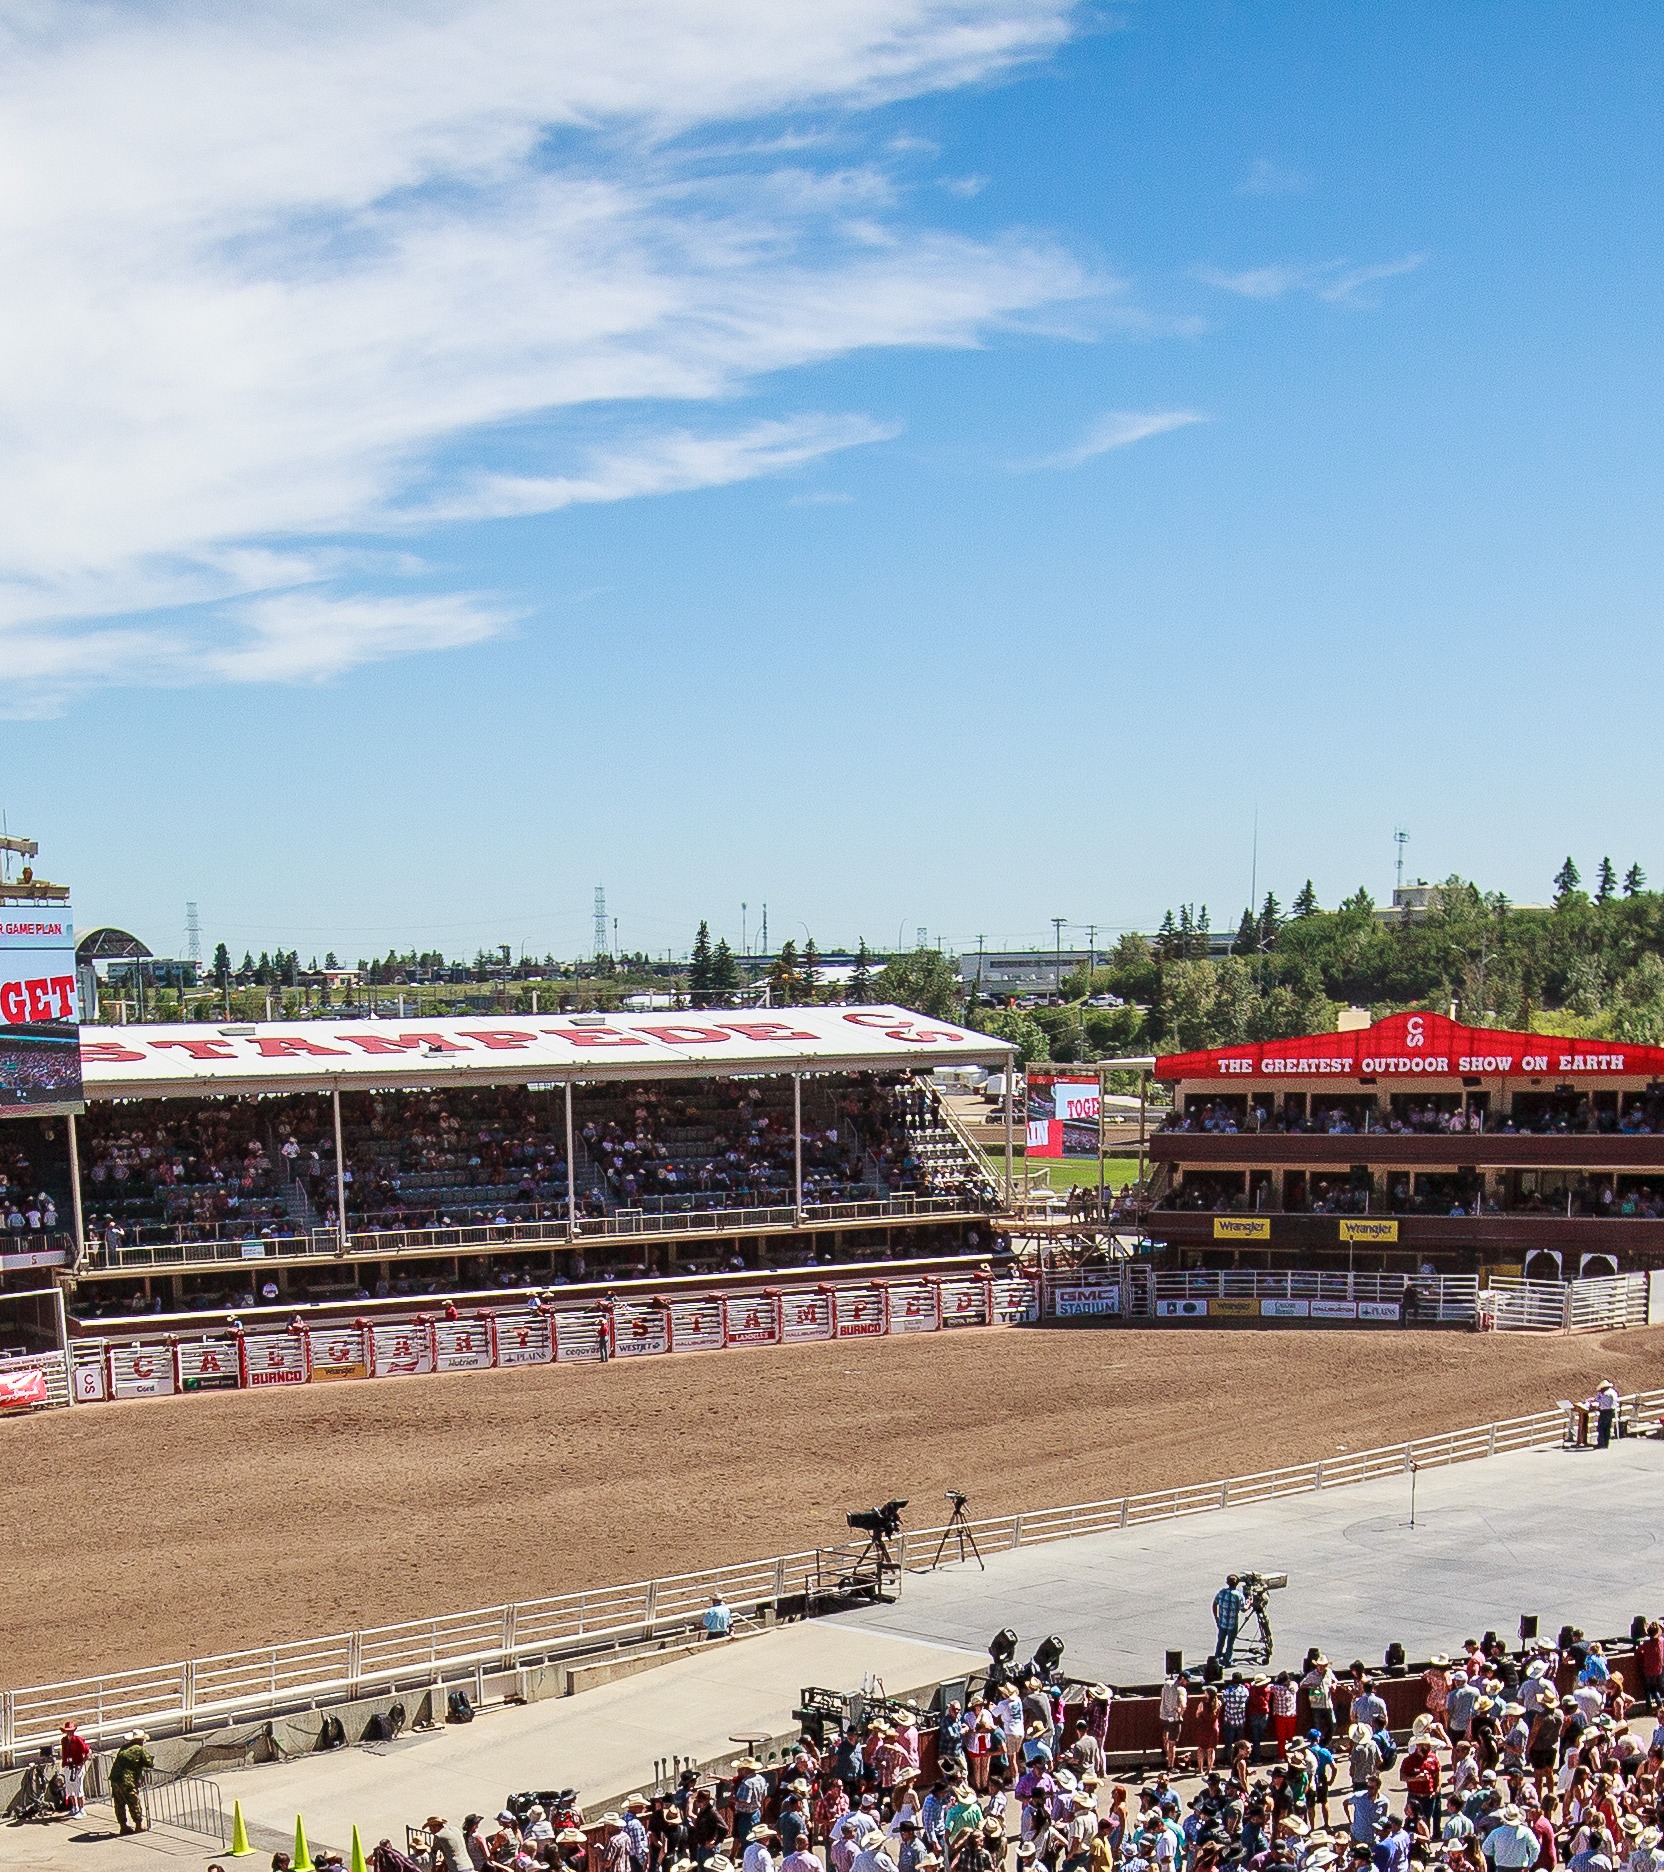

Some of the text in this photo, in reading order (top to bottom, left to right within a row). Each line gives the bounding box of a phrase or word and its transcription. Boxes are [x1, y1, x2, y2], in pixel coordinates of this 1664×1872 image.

[5, 923, 34, 935] GAME
[35, 923, 62, 935] PLAN
[1217, 1054, 1625, 1073] THE GREATEST OUTDOOR SHOW ON EARTH
[1218, 1220, 1266, 1237] Wrangler
[1344, 1222, 1393, 1239] Wrangler
[1058, 1288, 1116, 1301] GMC
[1059, 1301, 1116, 1316] STADIUM
[839, 1322, 882, 1336] BURNCO
[618, 1341, 653, 1353] WESTJET
[516, 1350, 547, 1363] PLAINS
[251, 1370, 302, 1386] BURNCO
